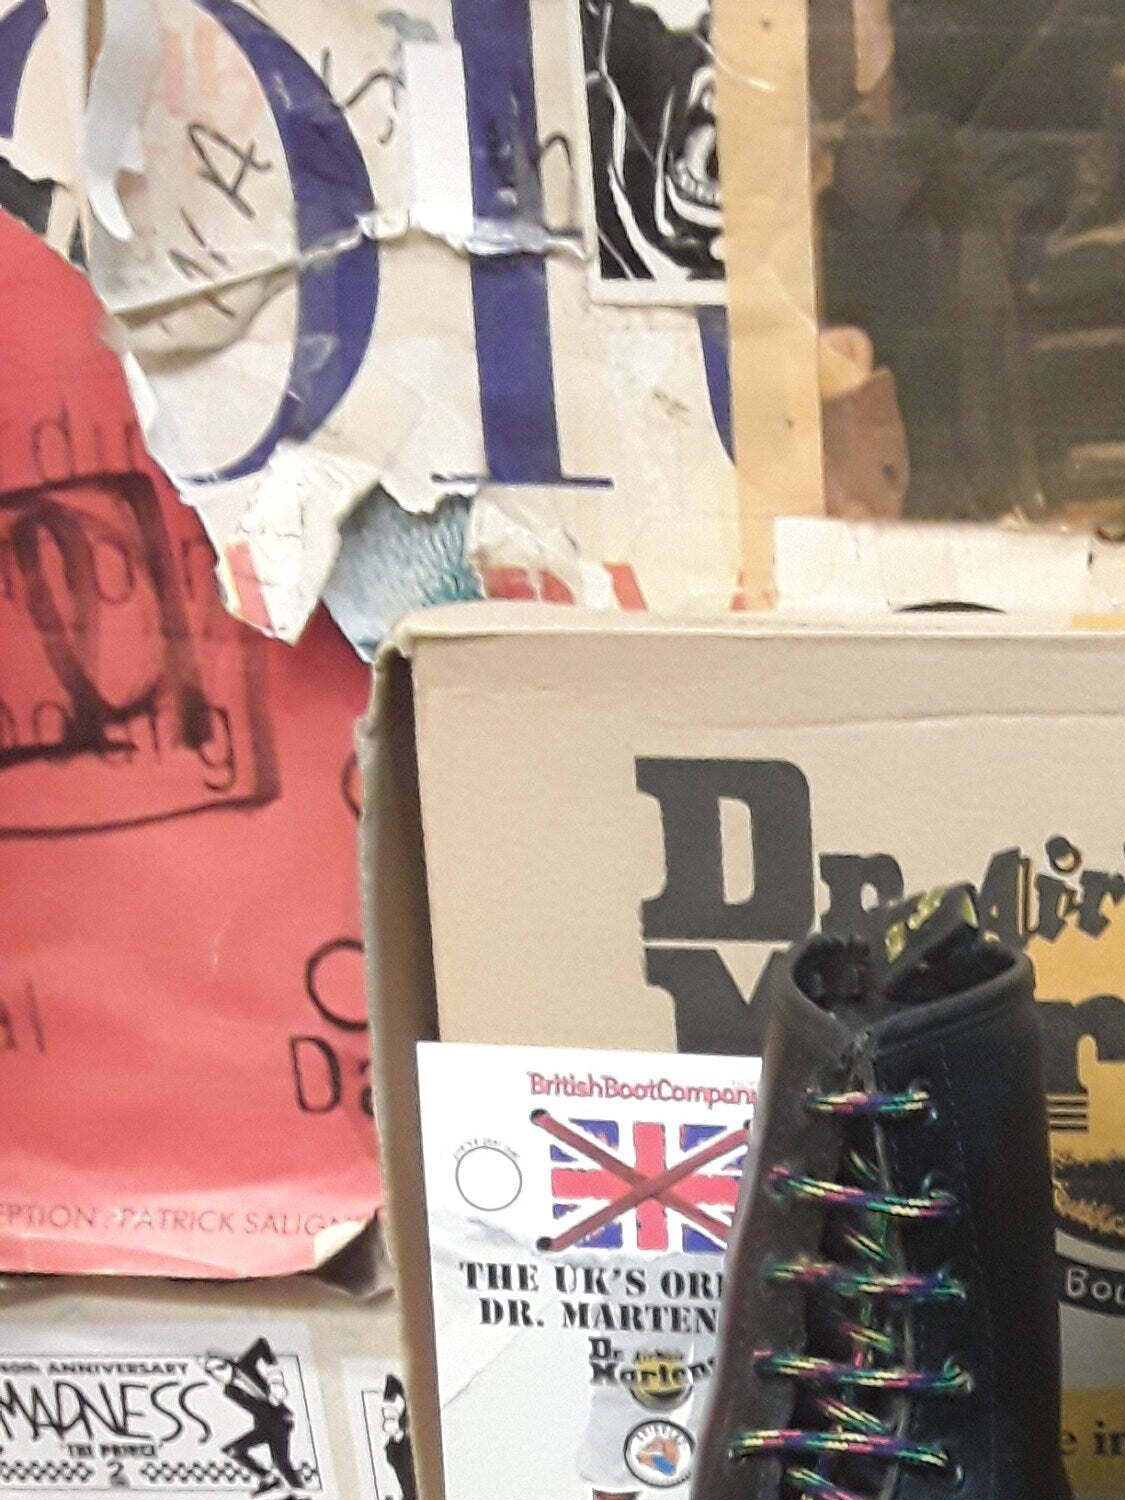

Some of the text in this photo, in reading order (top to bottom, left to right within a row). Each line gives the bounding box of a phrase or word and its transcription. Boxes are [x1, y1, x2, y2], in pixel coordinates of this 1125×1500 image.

[528, 1071, 757, 1110] BritishBootCompan
[119, 1205, 235, 1234] PATRICK
[458, 1261, 540, 1293] THE
[554, 1265, 647, 1297] UK'S
[478, 1297, 717, 1334] DR. MARTEN
[49, 1361, 189, 1376] ANNIVERSARY
